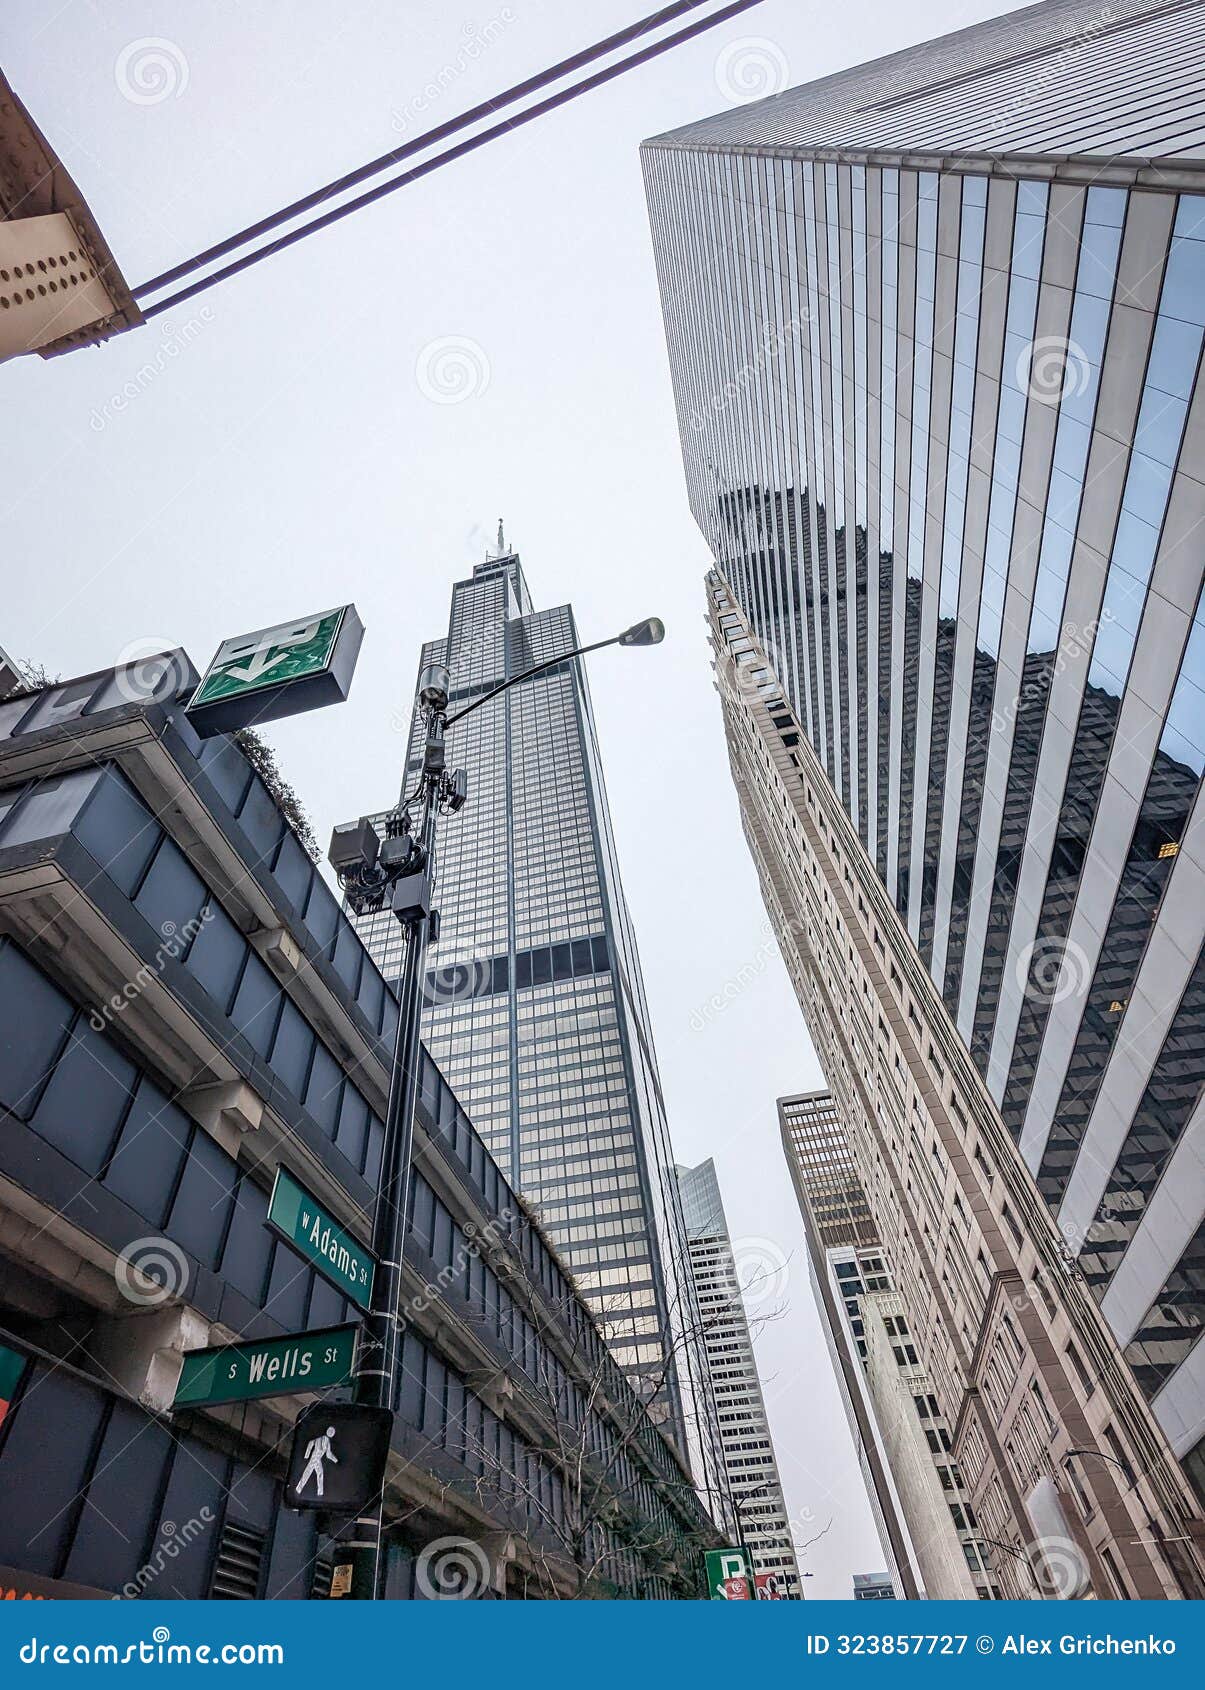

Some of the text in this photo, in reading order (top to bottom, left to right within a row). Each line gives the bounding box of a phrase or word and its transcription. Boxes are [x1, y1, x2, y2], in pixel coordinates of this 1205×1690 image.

[302, 1211, 368, 1286] W Adams St
[228, 1347, 338, 1384] S Wells St
